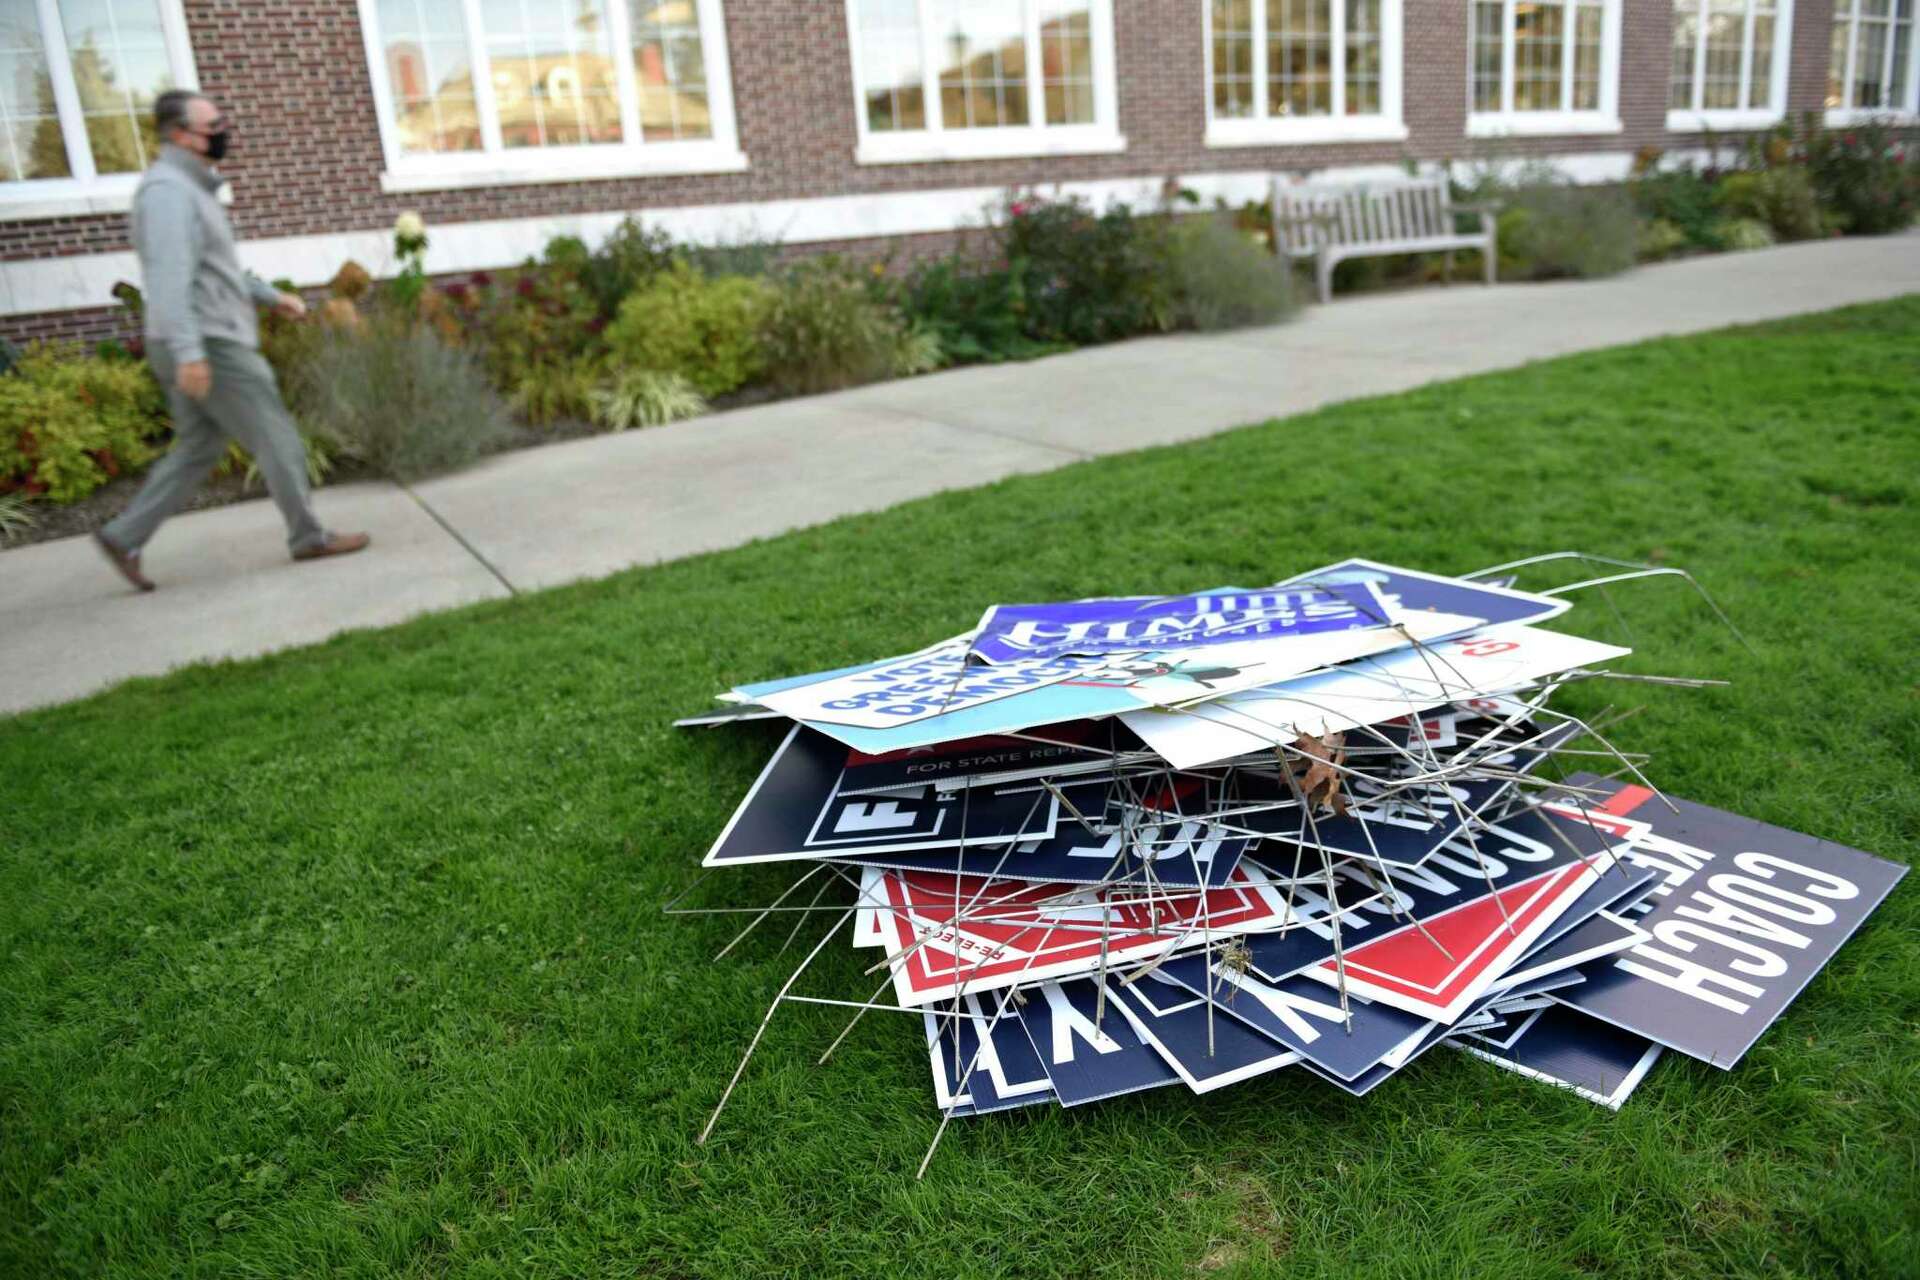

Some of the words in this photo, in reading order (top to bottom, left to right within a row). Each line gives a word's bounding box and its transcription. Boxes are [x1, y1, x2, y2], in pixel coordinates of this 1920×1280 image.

[851, 653, 964, 683] VOTE
[820, 664, 1016, 711] GREEN
[906, 760, 952, 775] FOR
[957, 751, 1022, 768] STATE
[1613, 851, 1860, 1015] COACH
